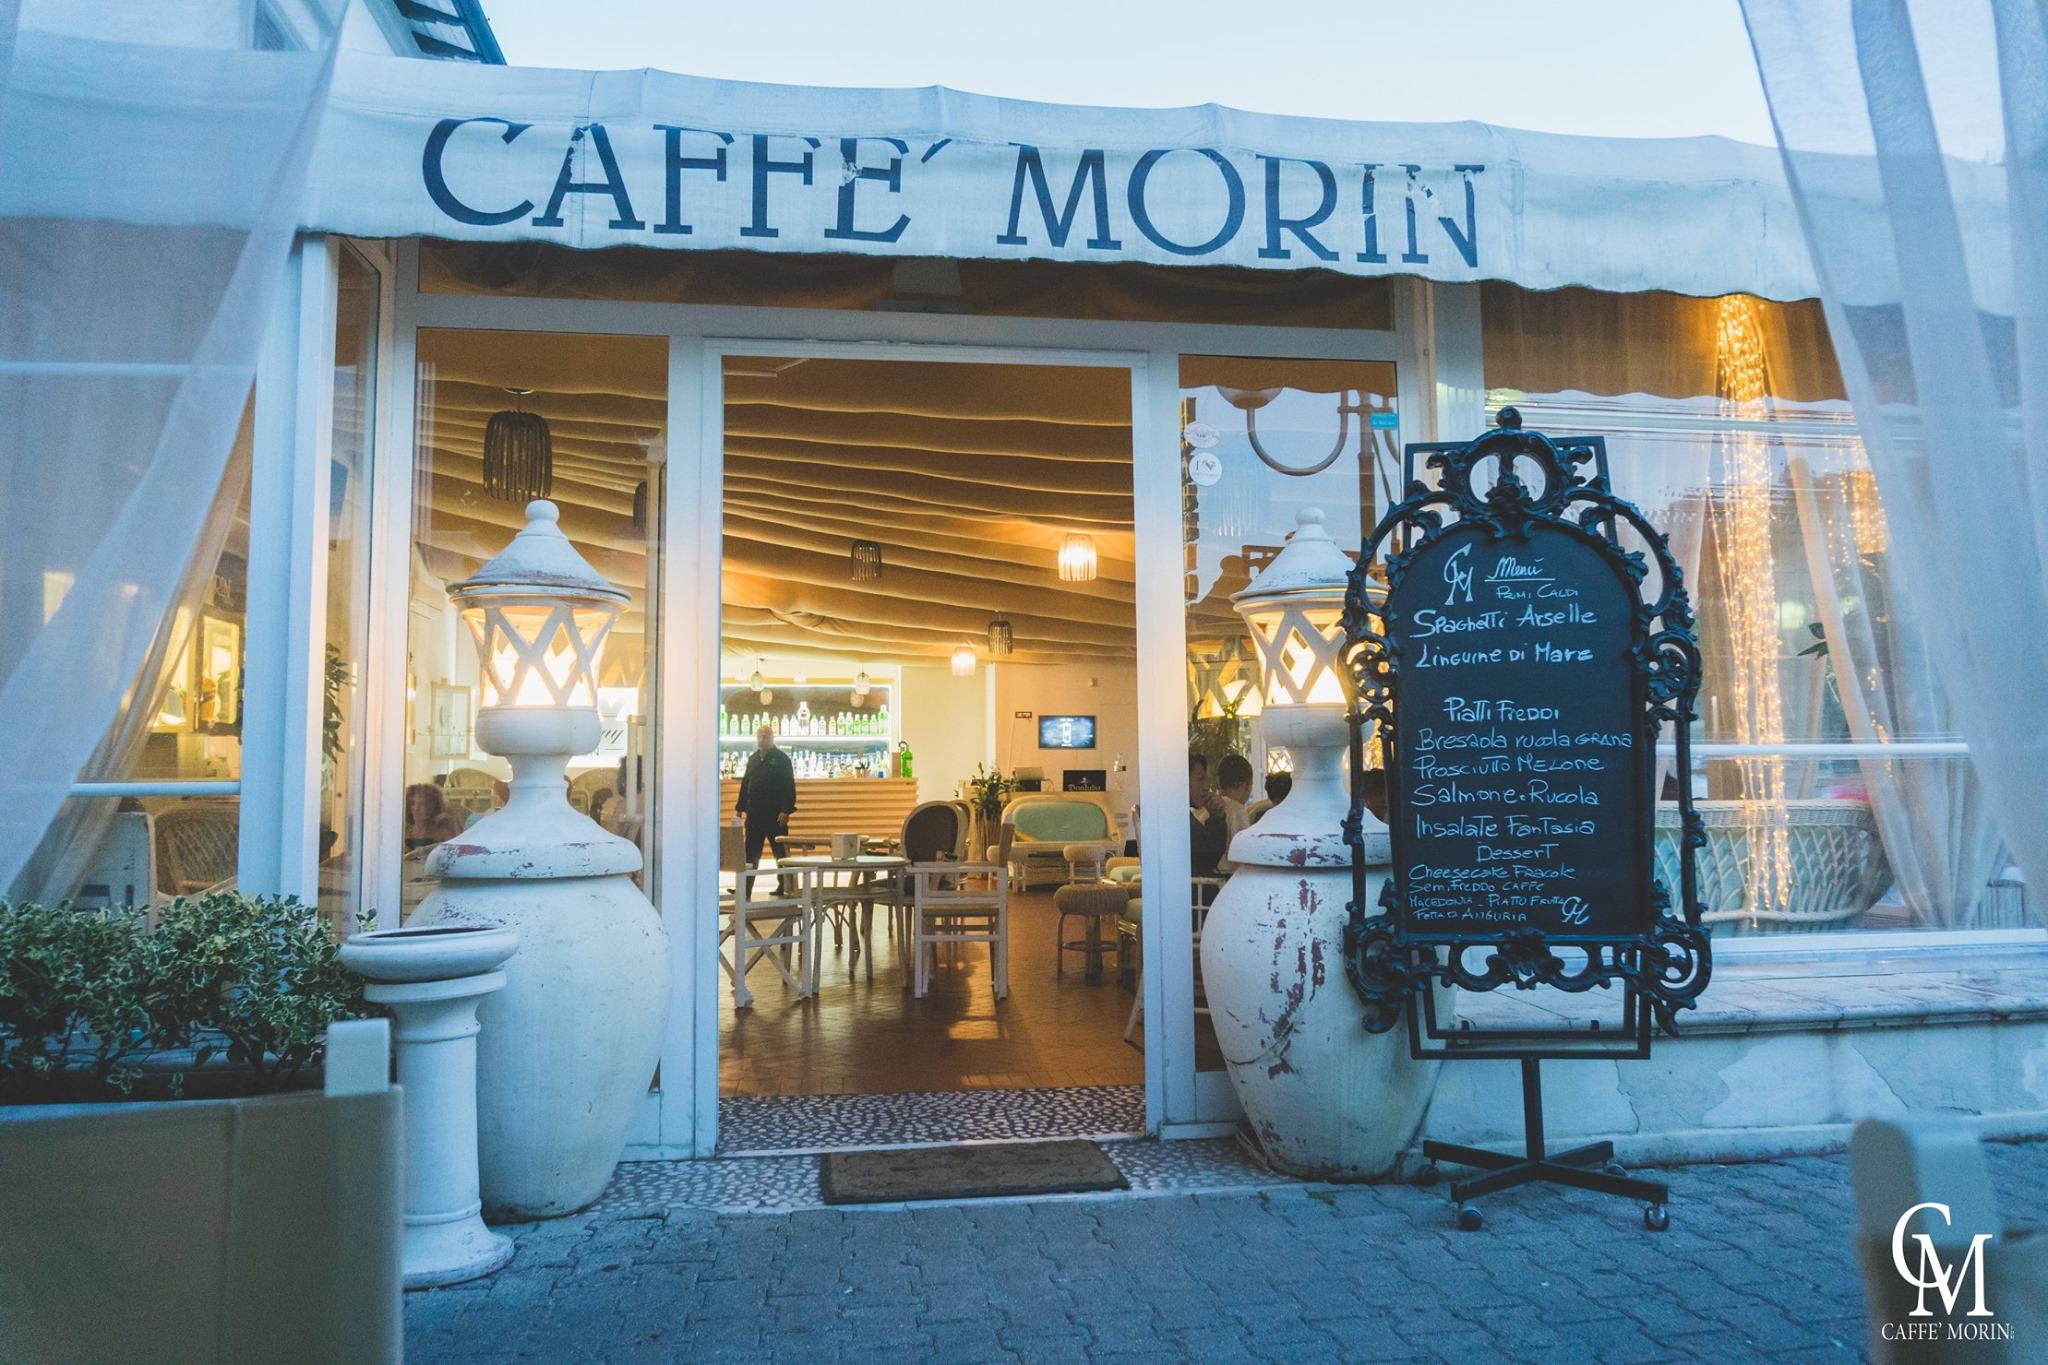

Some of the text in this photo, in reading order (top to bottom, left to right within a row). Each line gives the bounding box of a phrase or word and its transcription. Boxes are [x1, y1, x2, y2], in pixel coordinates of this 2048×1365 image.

[996, 142, 1485, 268] MORIN
[1516, 603, 1597, 627] Arselle
[1535, 641, 1594, 662] Mare
[1415, 728, 1508, 751] Bresaola
[1411, 781, 1516, 806] Salmone
[1528, 779, 1600, 805] Rucola
